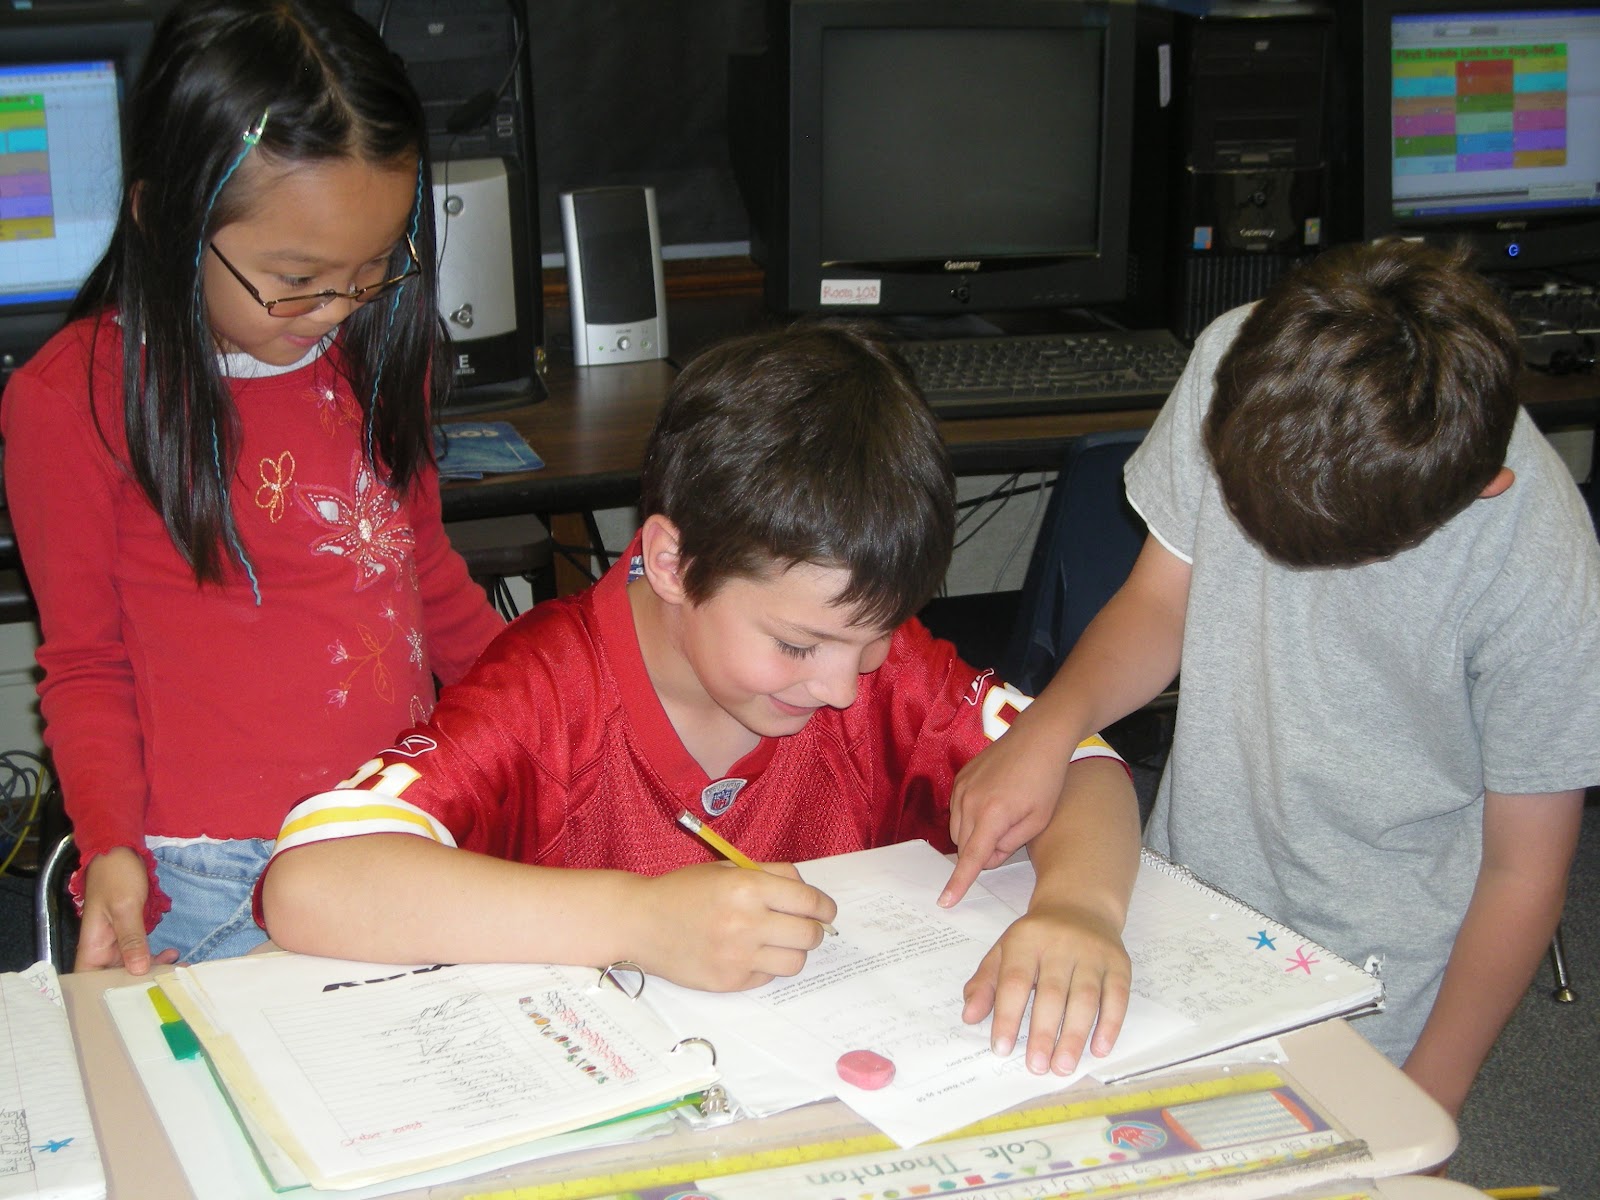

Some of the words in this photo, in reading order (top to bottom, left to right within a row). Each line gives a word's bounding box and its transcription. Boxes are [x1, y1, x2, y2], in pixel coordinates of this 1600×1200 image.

[944, 260, 981, 271] Gateway
[823, 286, 853, 299] Room
[855, 285, 877, 300] 103
[458, 354, 469, 368] E
[979, 1138, 1053, 1166] Cole
[806, 1152, 973, 1186] Thornton
